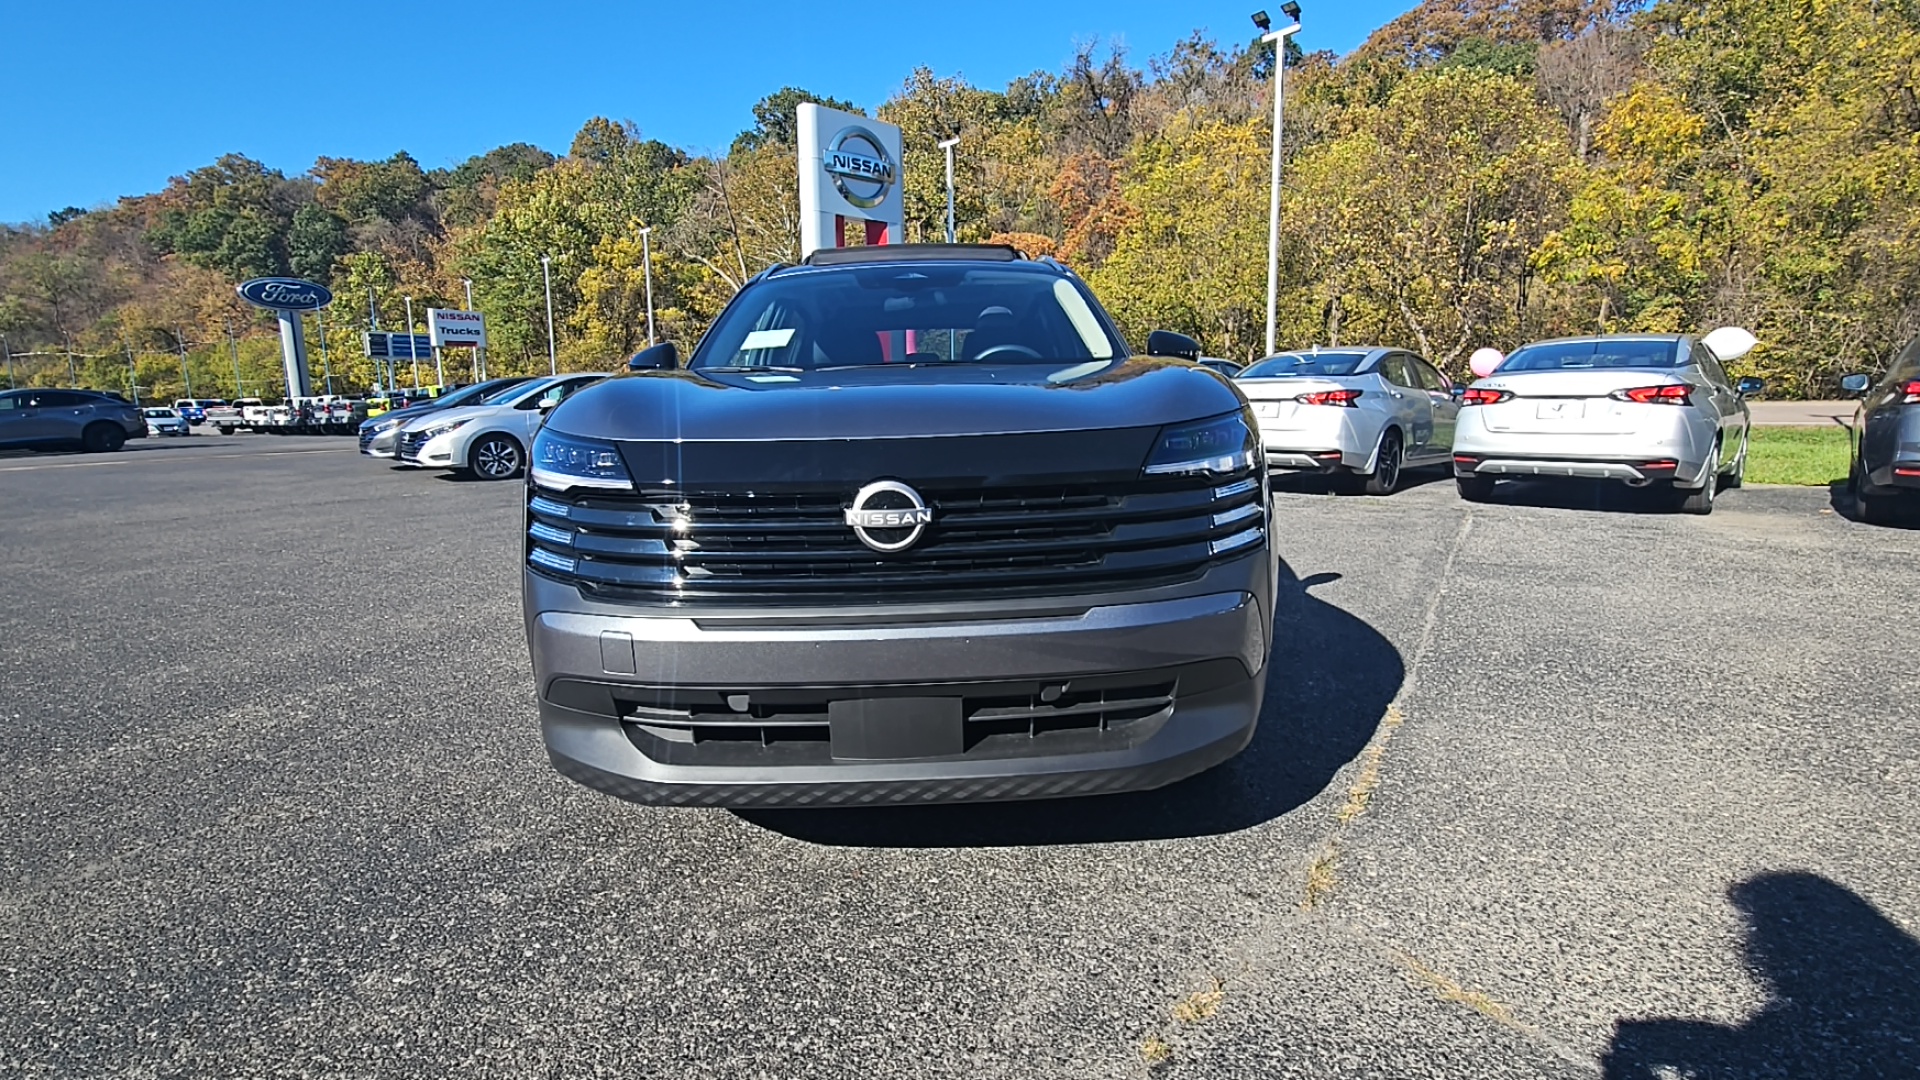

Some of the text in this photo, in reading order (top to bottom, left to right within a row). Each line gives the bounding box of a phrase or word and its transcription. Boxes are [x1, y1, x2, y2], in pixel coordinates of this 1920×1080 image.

[833, 155, 892, 178] NISSAN
[261, 283, 317, 304] Ford
[436, 312, 481, 322] NISSAN
[439, 326, 481, 336] Trucks
[846, 511, 931, 525] NISSAN
